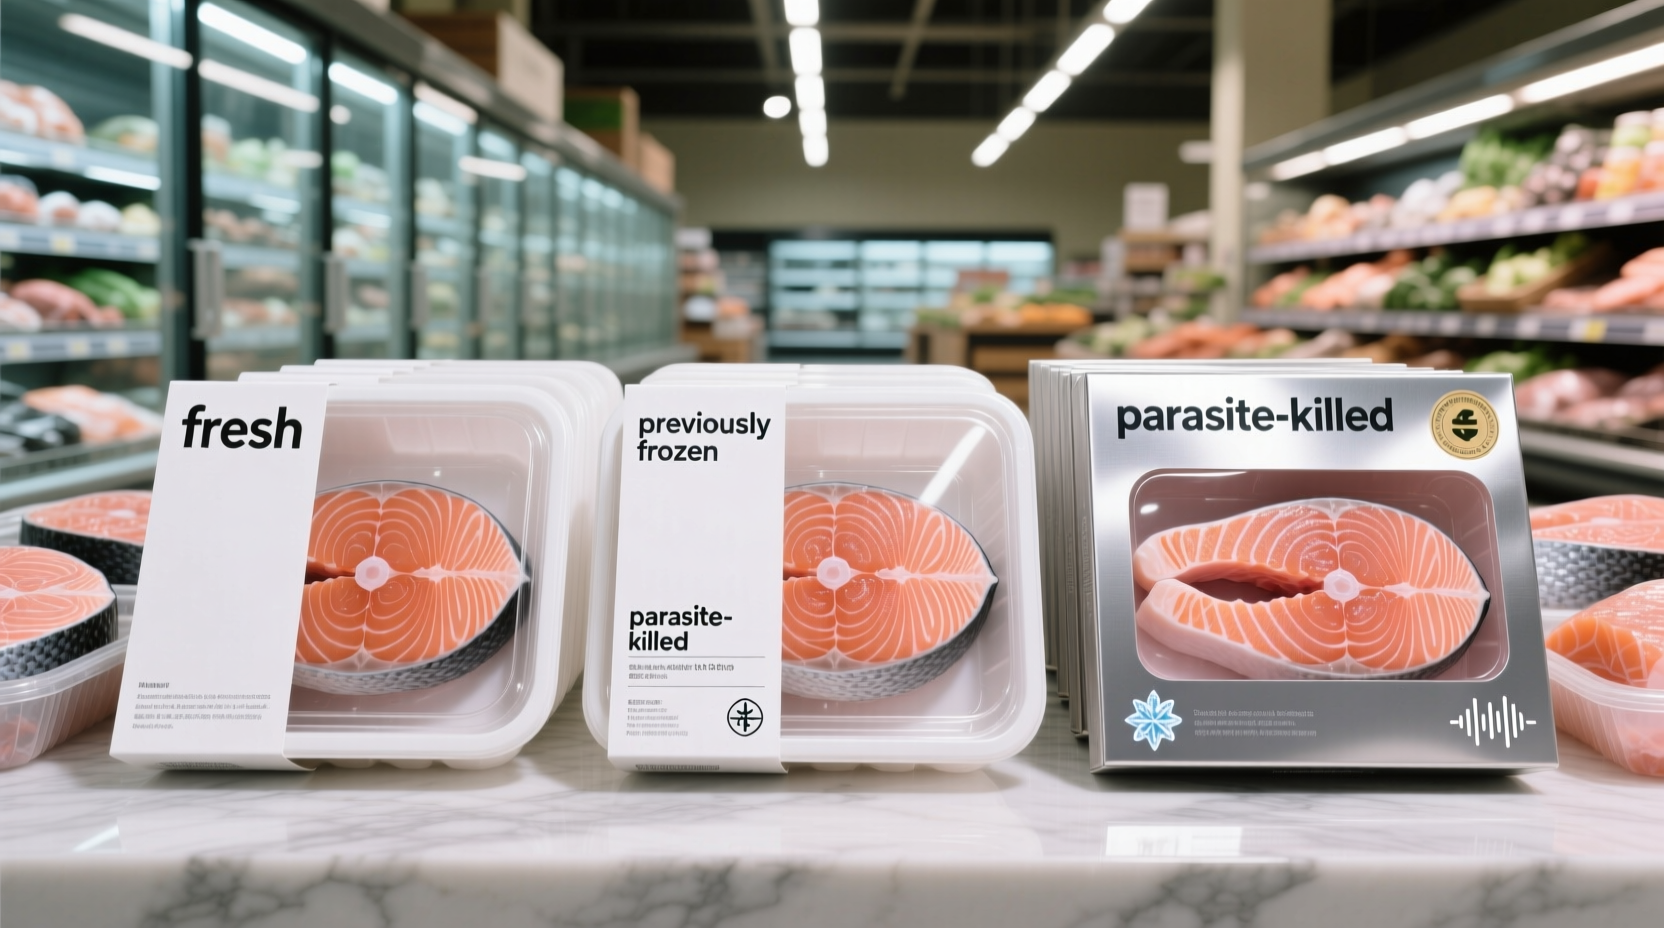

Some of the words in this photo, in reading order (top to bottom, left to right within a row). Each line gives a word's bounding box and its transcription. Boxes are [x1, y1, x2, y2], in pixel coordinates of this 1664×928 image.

[181, 404, 303, 450] fresh
[638, 411, 771, 440] previously
[1117, 396, 1393, 439] parasite-killed
[636, 439, 718, 462] frozen
[629, 604, 733, 630] parasite-
[628, 630, 689, 651] killed
